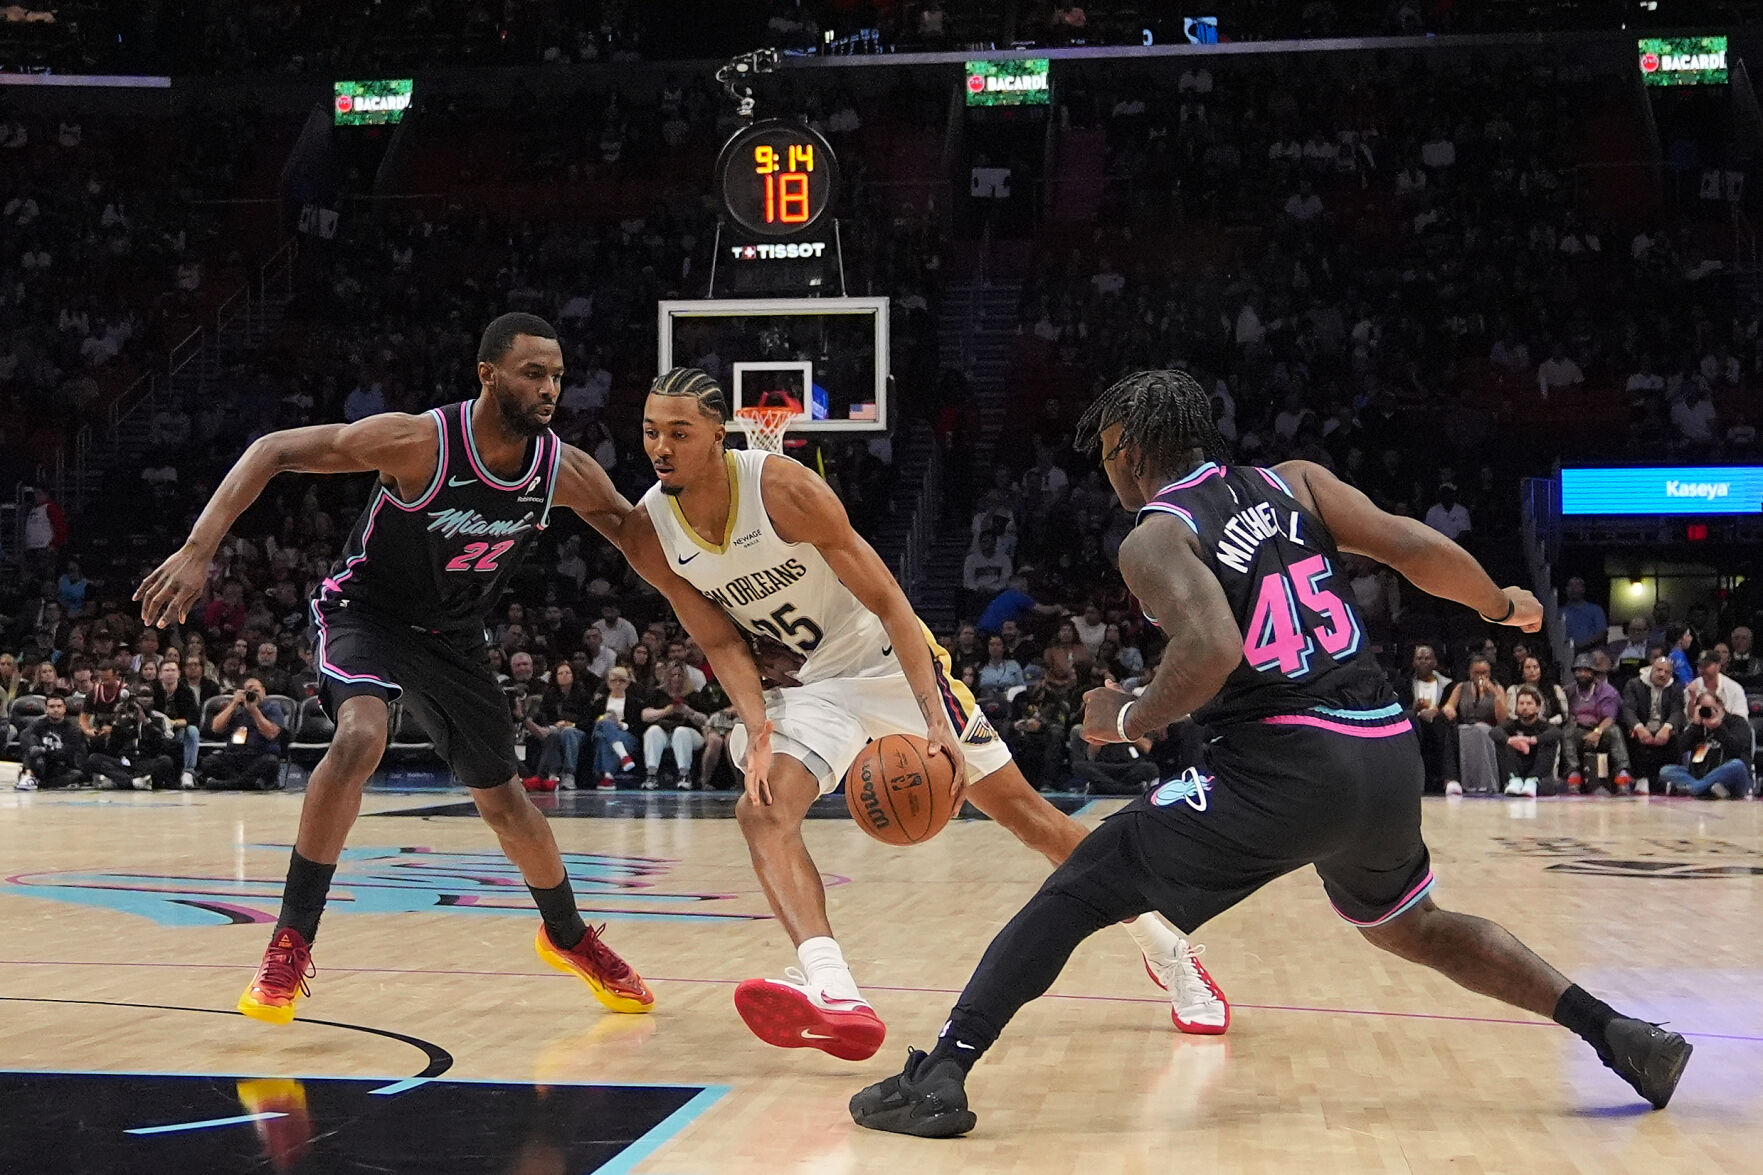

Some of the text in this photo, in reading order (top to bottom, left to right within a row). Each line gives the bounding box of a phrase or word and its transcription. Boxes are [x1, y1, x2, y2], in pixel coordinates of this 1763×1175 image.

[755, 144, 814, 174] 9:14
[764, 172, 810, 224] 18
[1666, 480, 1730, 501] Kaseya
[427, 508, 534, 540] Miami
[445, 540, 515, 572] 22
[725, 557, 807, 607] ORLEANS
[1243, 553, 1361, 679] 45
